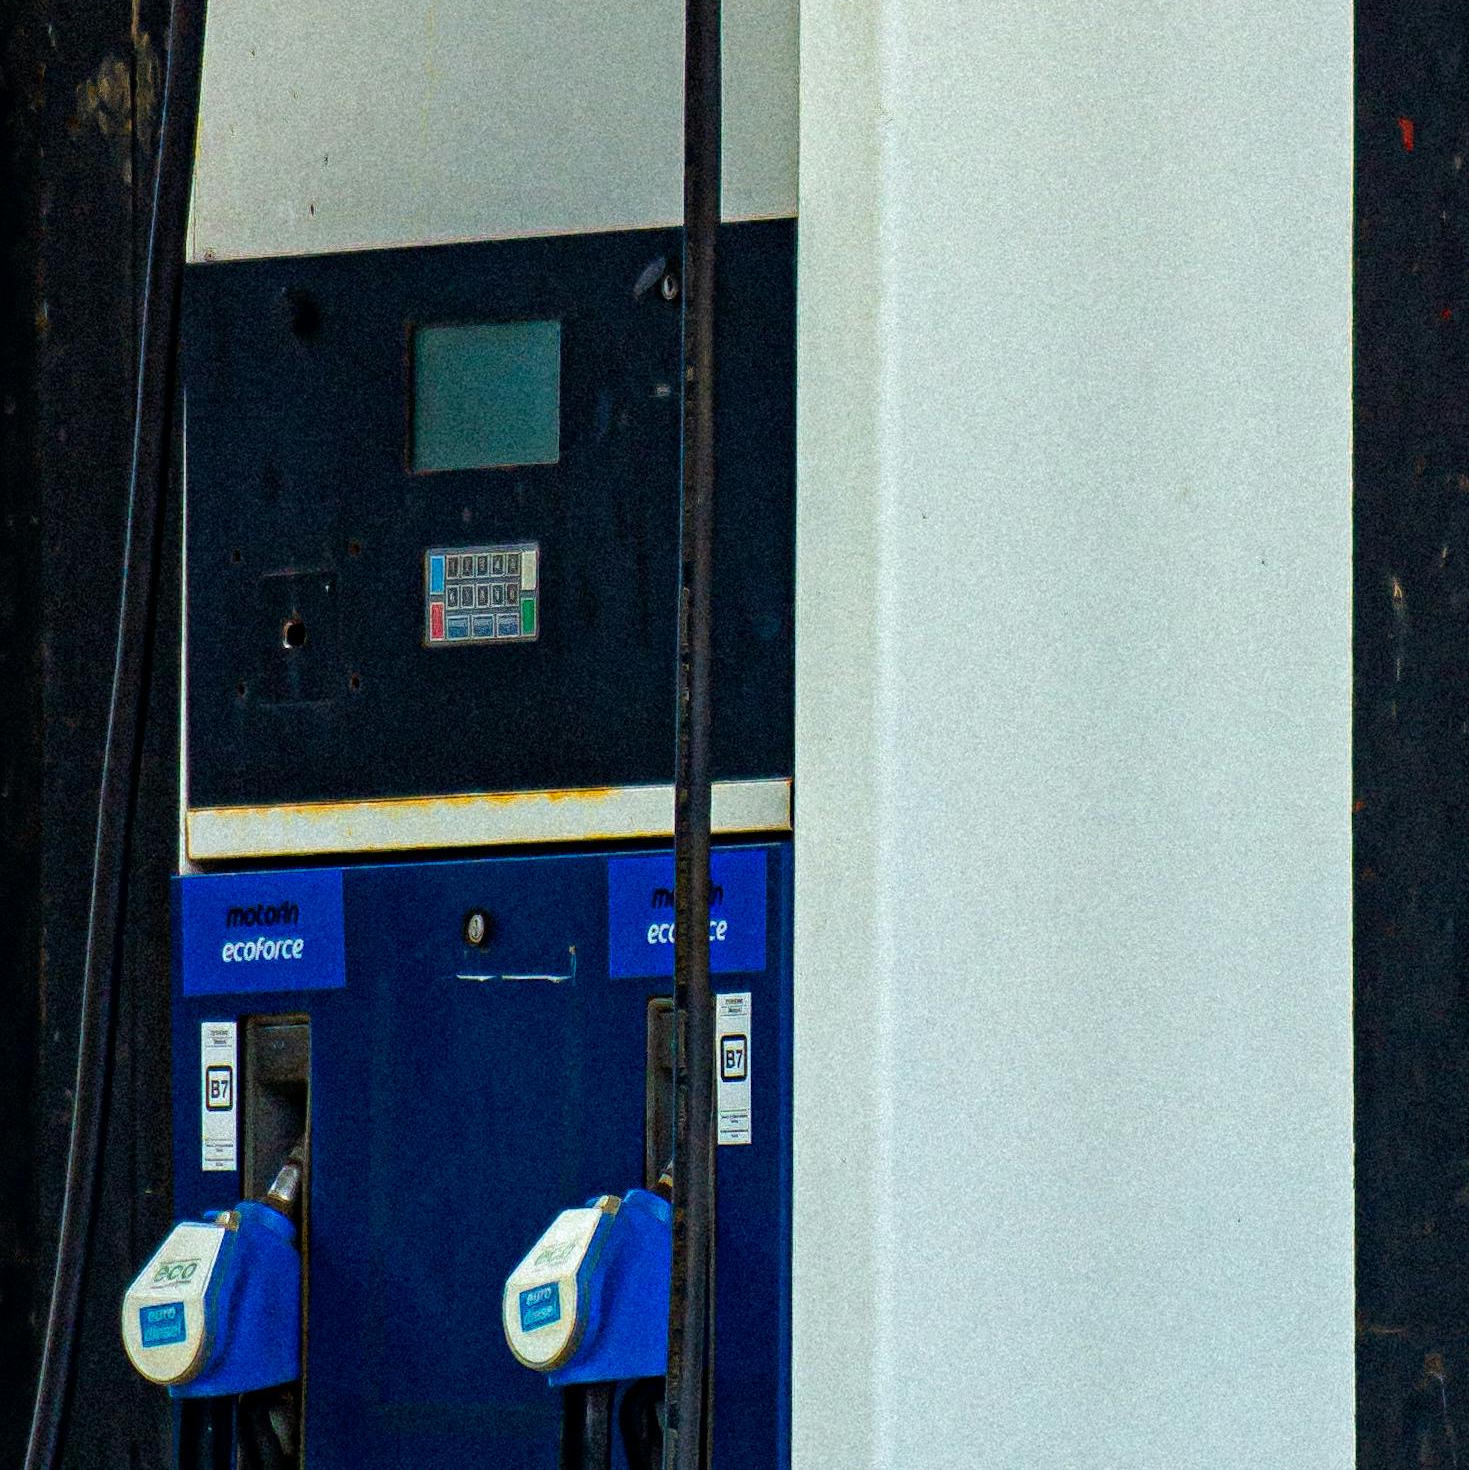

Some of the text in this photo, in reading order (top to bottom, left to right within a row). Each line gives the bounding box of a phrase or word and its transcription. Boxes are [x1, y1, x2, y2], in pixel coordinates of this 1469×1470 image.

[225, 900, 299, 928] motorin
[222, 936, 304, 963] ecoforce
[726, 1049, 743, 1069] B7
[211, 1079, 229, 1099] B7
[153, 1262, 198, 1283] eco
[525, 1287, 552, 1307] euro
[147, 1306, 176, 1323] euro
